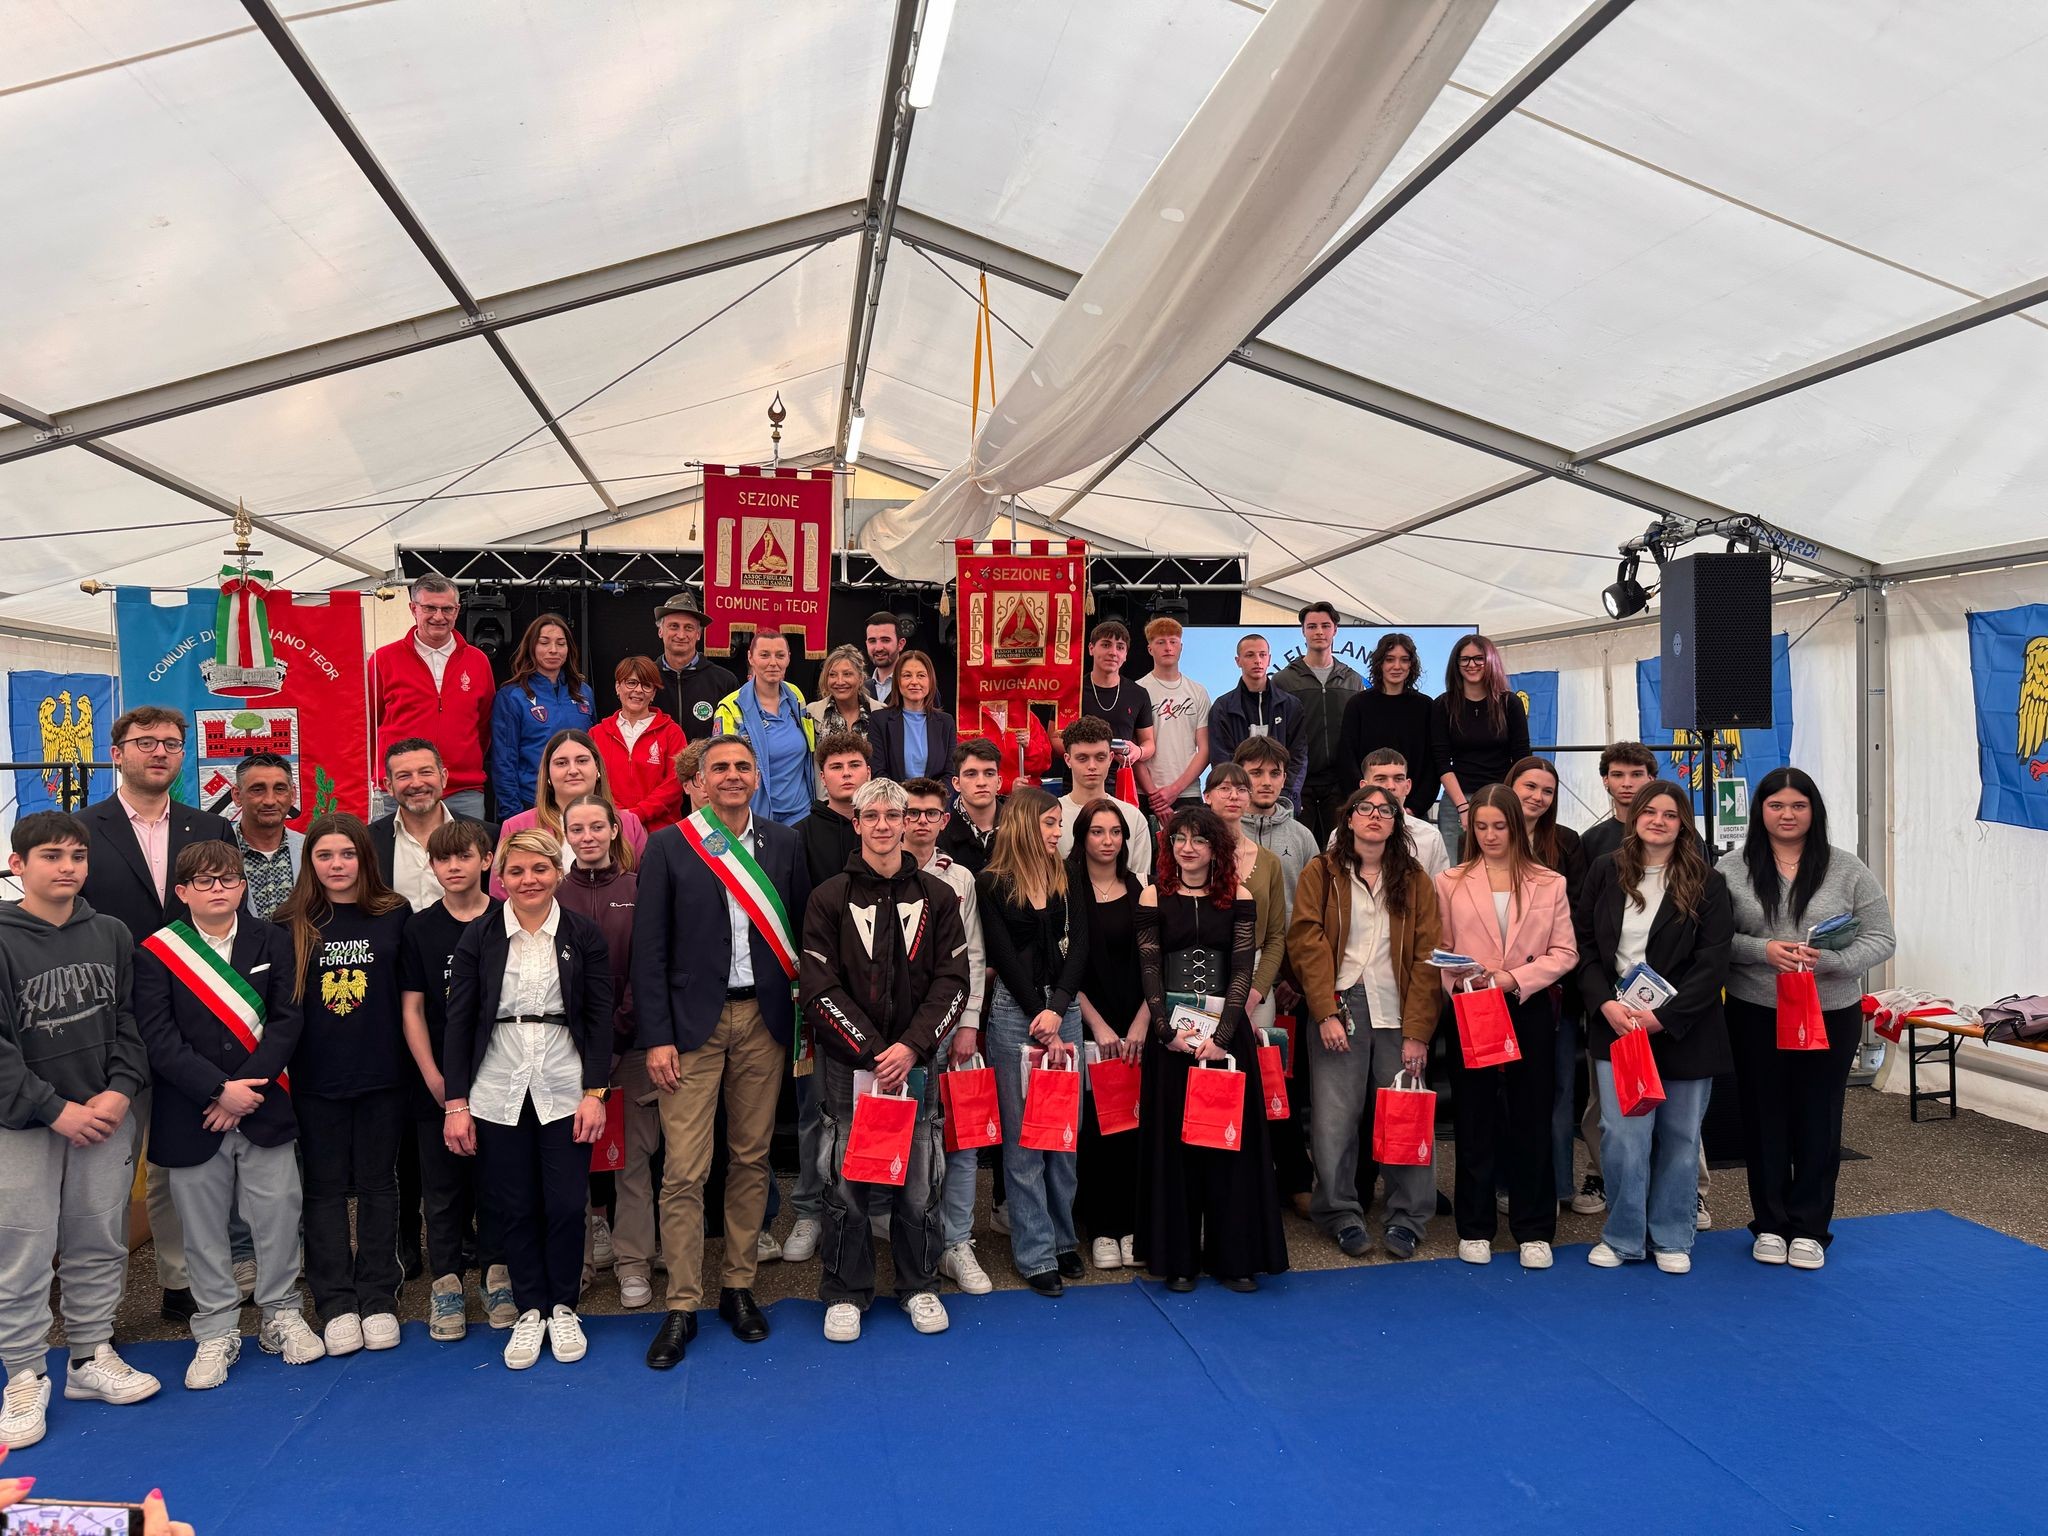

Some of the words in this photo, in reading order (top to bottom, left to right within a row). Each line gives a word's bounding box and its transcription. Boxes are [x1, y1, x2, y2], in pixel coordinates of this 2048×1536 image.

[738, 491, 800, 509] SEZIONE
[992, 568, 1051, 581] SEZIONE
[715, 595, 770, 612] COMUNE
[785, 599, 818, 614] TEOR
[971, 598, 983, 660] AFDS
[1055, 598, 1071, 660] AFDS
[148, 635, 199, 682] COMUNE
[308, 647, 341, 682] TEOR
[979, 678, 1060, 693] RIVIGNANO
[324, 939, 370, 952] ZOVINS
[319, 952, 375, 967] FURLANS
[819, 996, 867, 1042] DAINESE
